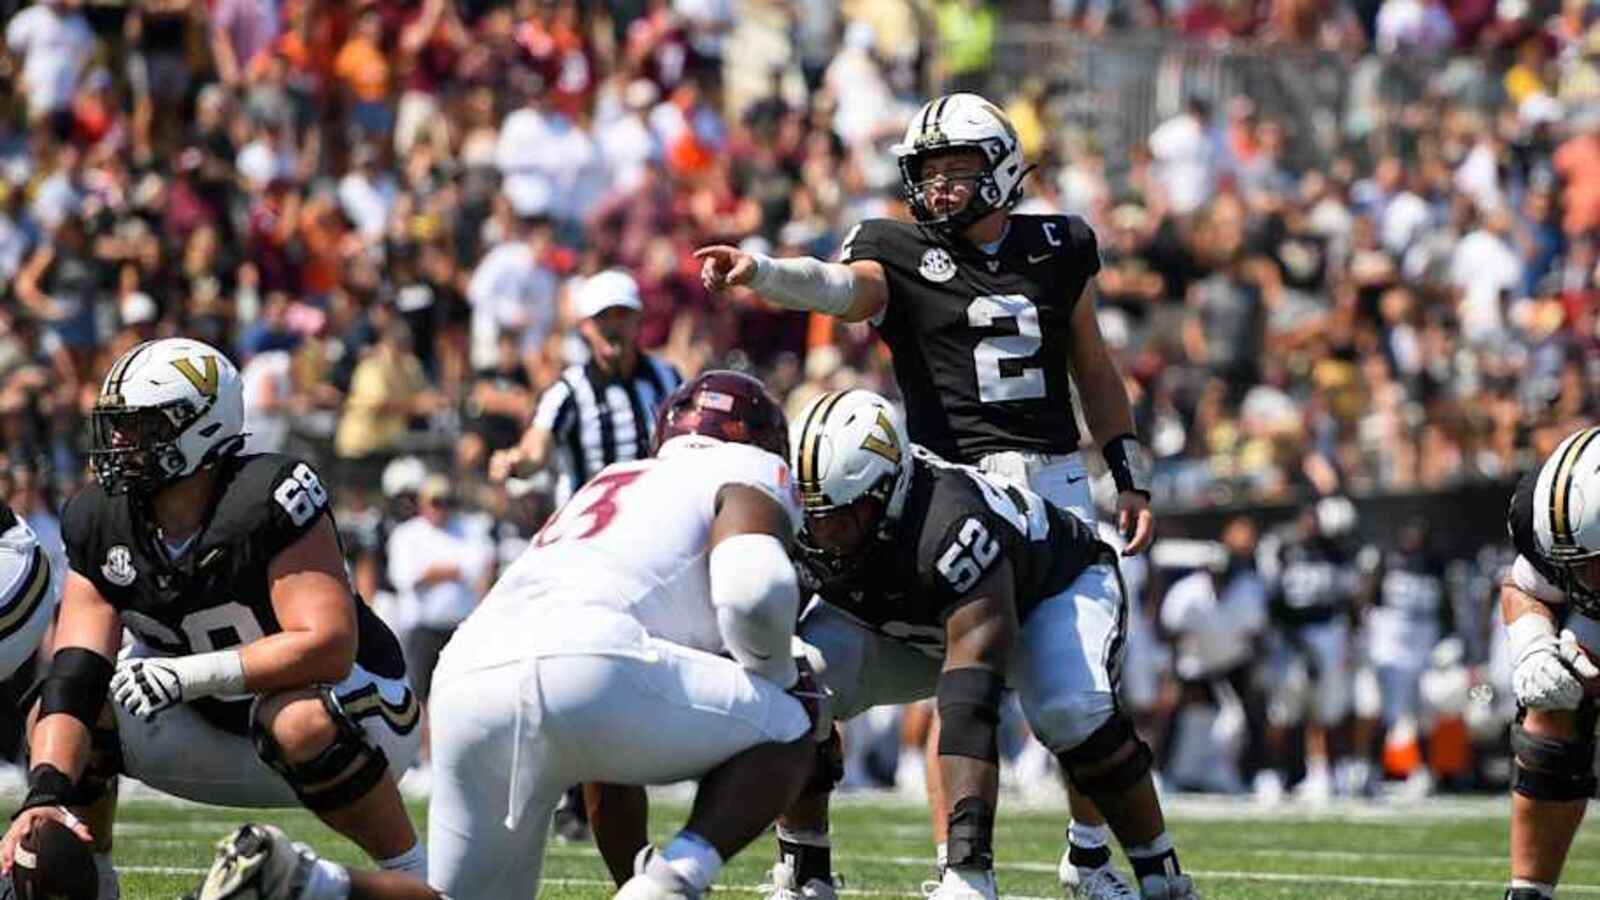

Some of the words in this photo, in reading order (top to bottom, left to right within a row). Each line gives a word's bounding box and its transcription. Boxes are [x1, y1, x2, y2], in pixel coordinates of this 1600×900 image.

[1042, 223, 1062, 246] C
[172, 355, 219, 397] V
[967, 294, 1046, 402] 2
[861, 411, 902, 463] V
[274, 462, 328, 526] 68
[937, 518, 999, 593] 52
